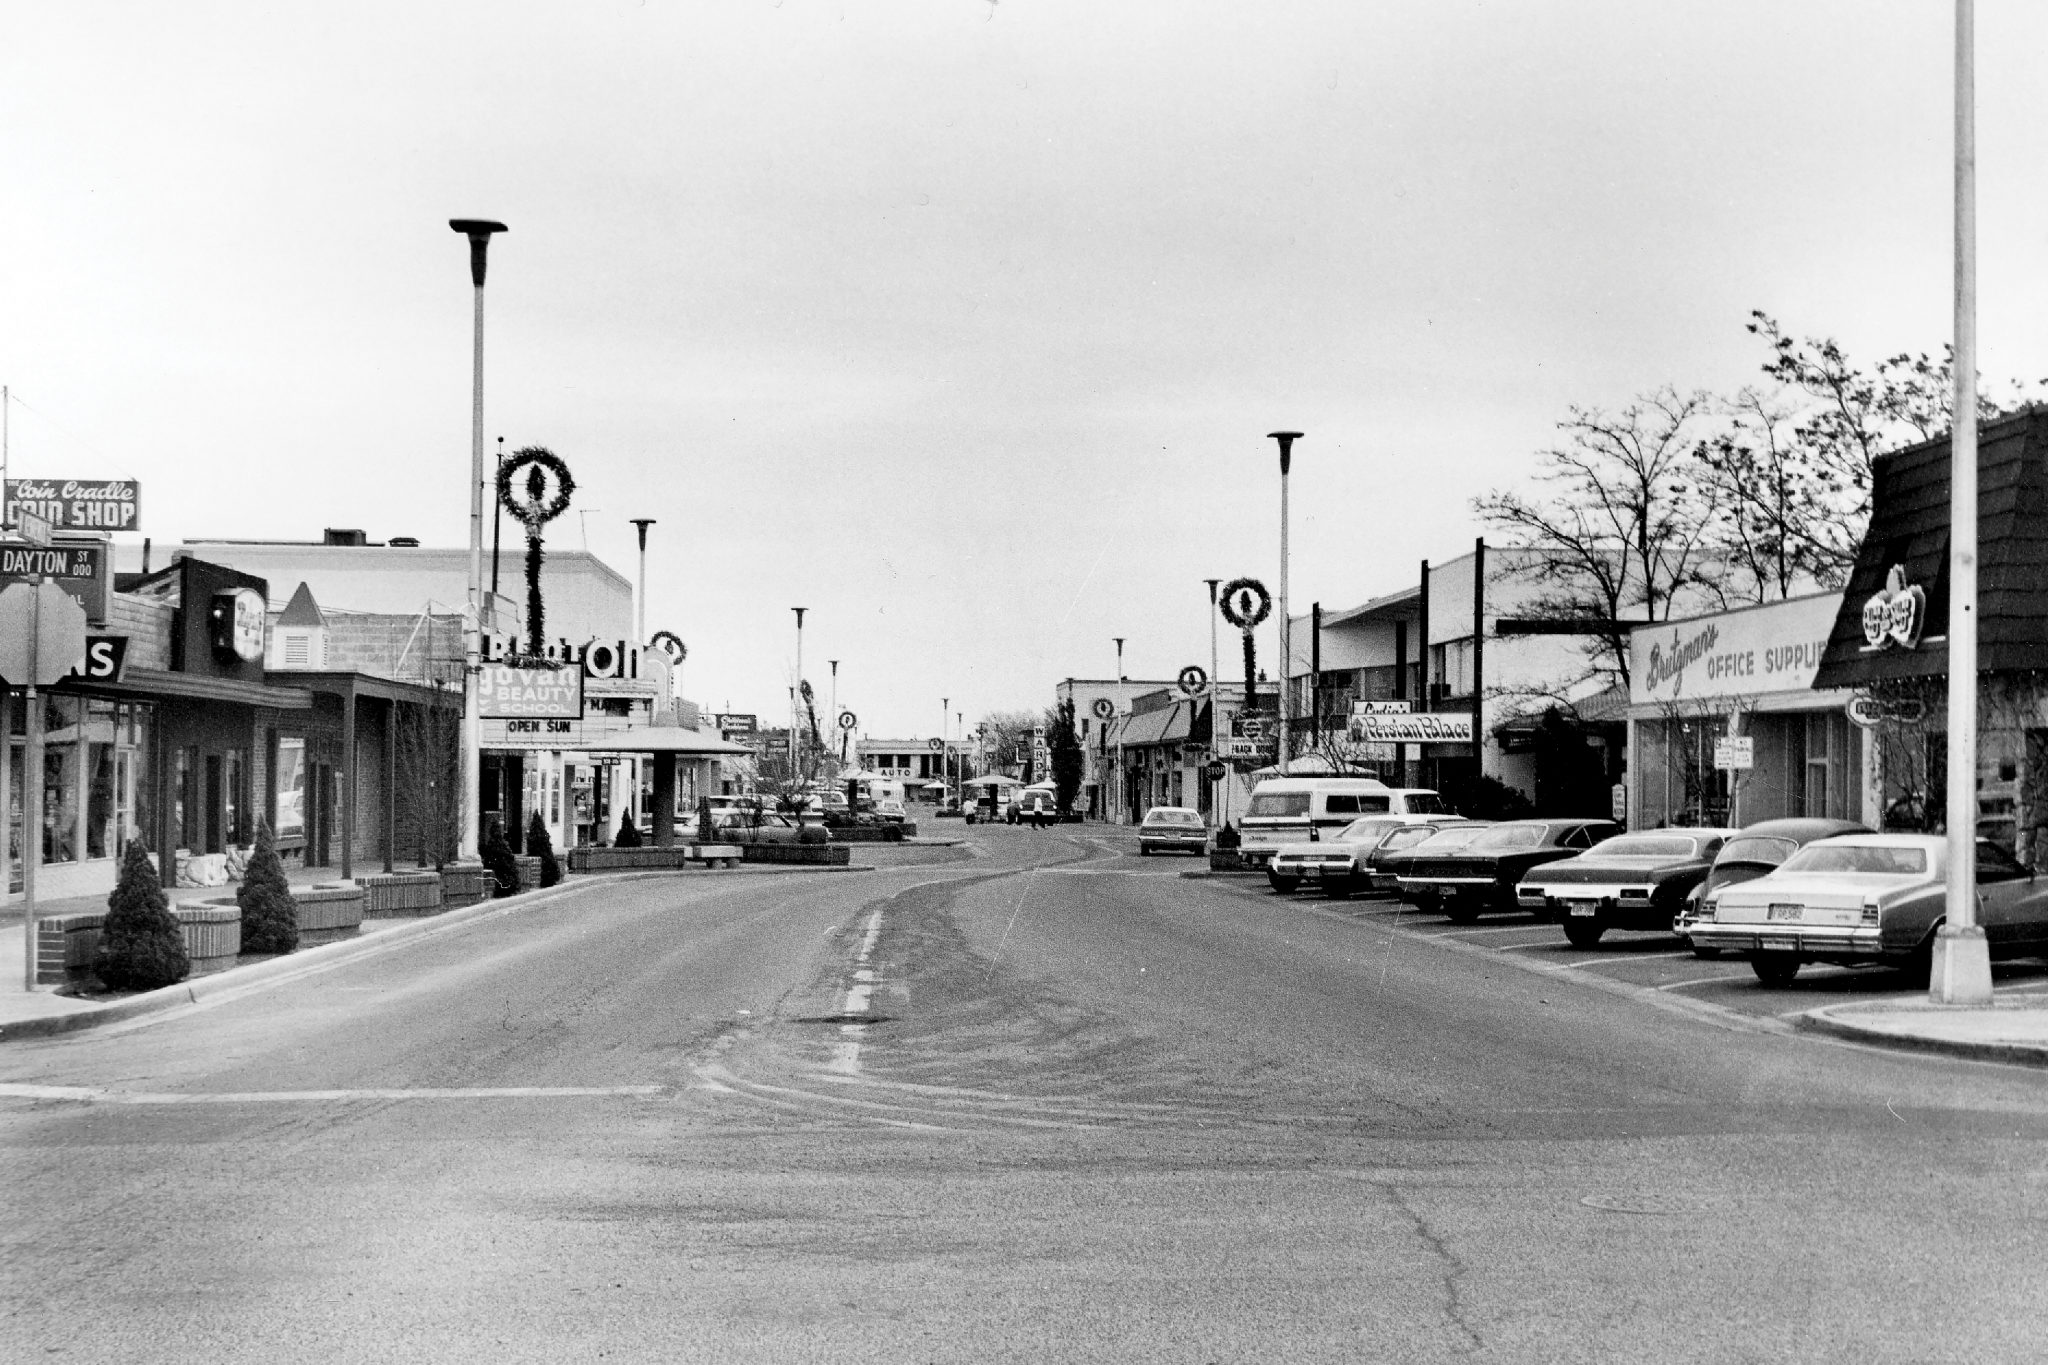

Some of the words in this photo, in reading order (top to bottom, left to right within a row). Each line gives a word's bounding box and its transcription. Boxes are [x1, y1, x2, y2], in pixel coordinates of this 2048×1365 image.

[17, 480, 57, 499] Coin
[62, 481, 134, 500] Cradle
[71, 501, 135, 526] SHOP
[4, 550, 67, 573] DAYTON
[78, 551, 88, 562] ST
[1708, 651, 1753, 680] OFFICE
[498, 687, 576, 701] BEAUTY
[500, 704, 570, 713] SCHOOL
[509, 721, 541, 733] OPEN
[547, 721, 571, 733] SUN
[1363, 717, 1422, 739] Persian
[1417, 717, 1470, 739] Palace
[1035, 728, 1044, 780] WARDS
[1206, 767, 1225, 776] STOP
